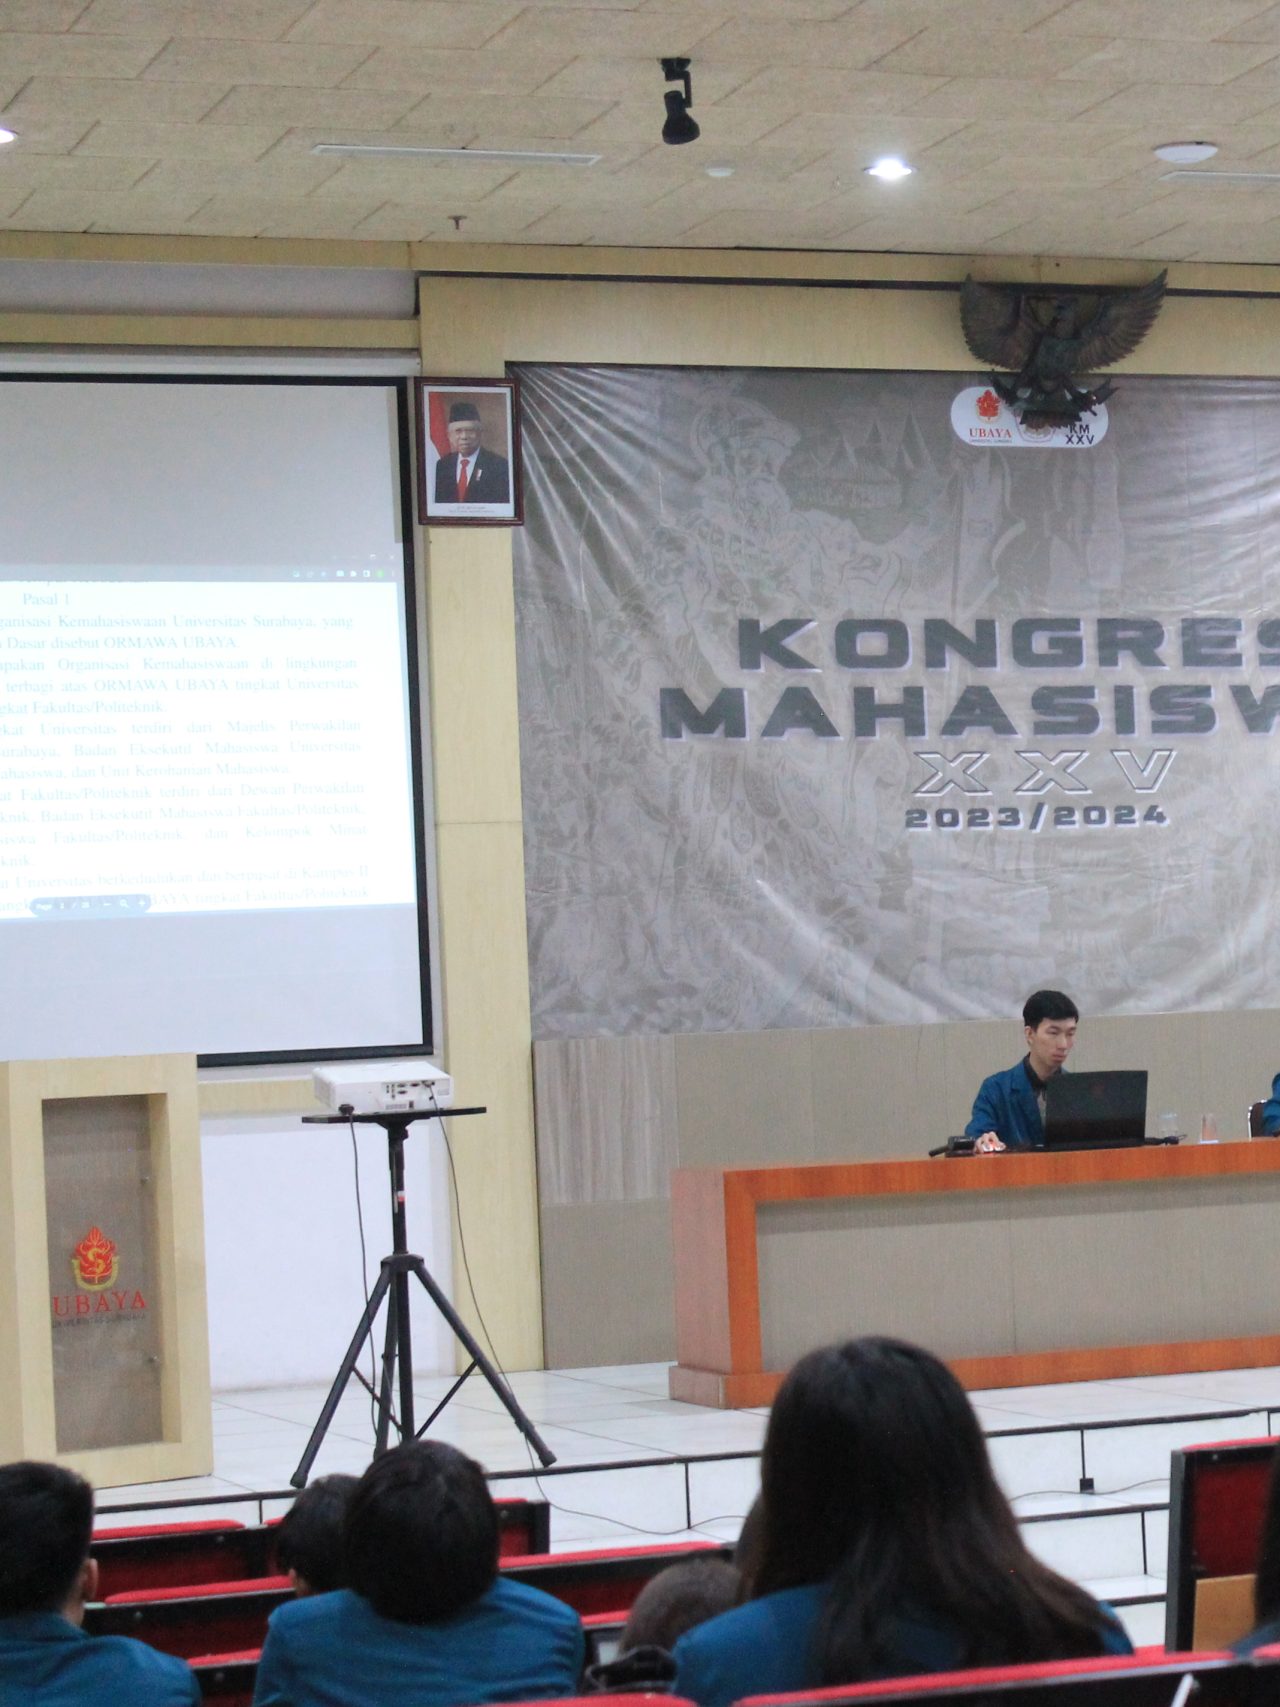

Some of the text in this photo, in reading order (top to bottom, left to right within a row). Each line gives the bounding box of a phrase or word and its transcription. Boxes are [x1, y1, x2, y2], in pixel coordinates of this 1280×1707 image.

[969, 428, 1012, 438] UBAYA
[1065, 435, 1095, 445] XXV
[23, 593, 58, 606] Pasal
[173, 615, 247, 628] Universitas
[322, 617, 354, 631] yang
[104, 636, 178, 649] ORMAWA
[94, 678, 168, 692] ORMAWA
[175, 678, 229, 691] UBAYA
[287, 677, 361, 690] Universitas
[905, 804, 1171, 832] 2023/2024
[52, 1289, 147, 1317] UBAYA
